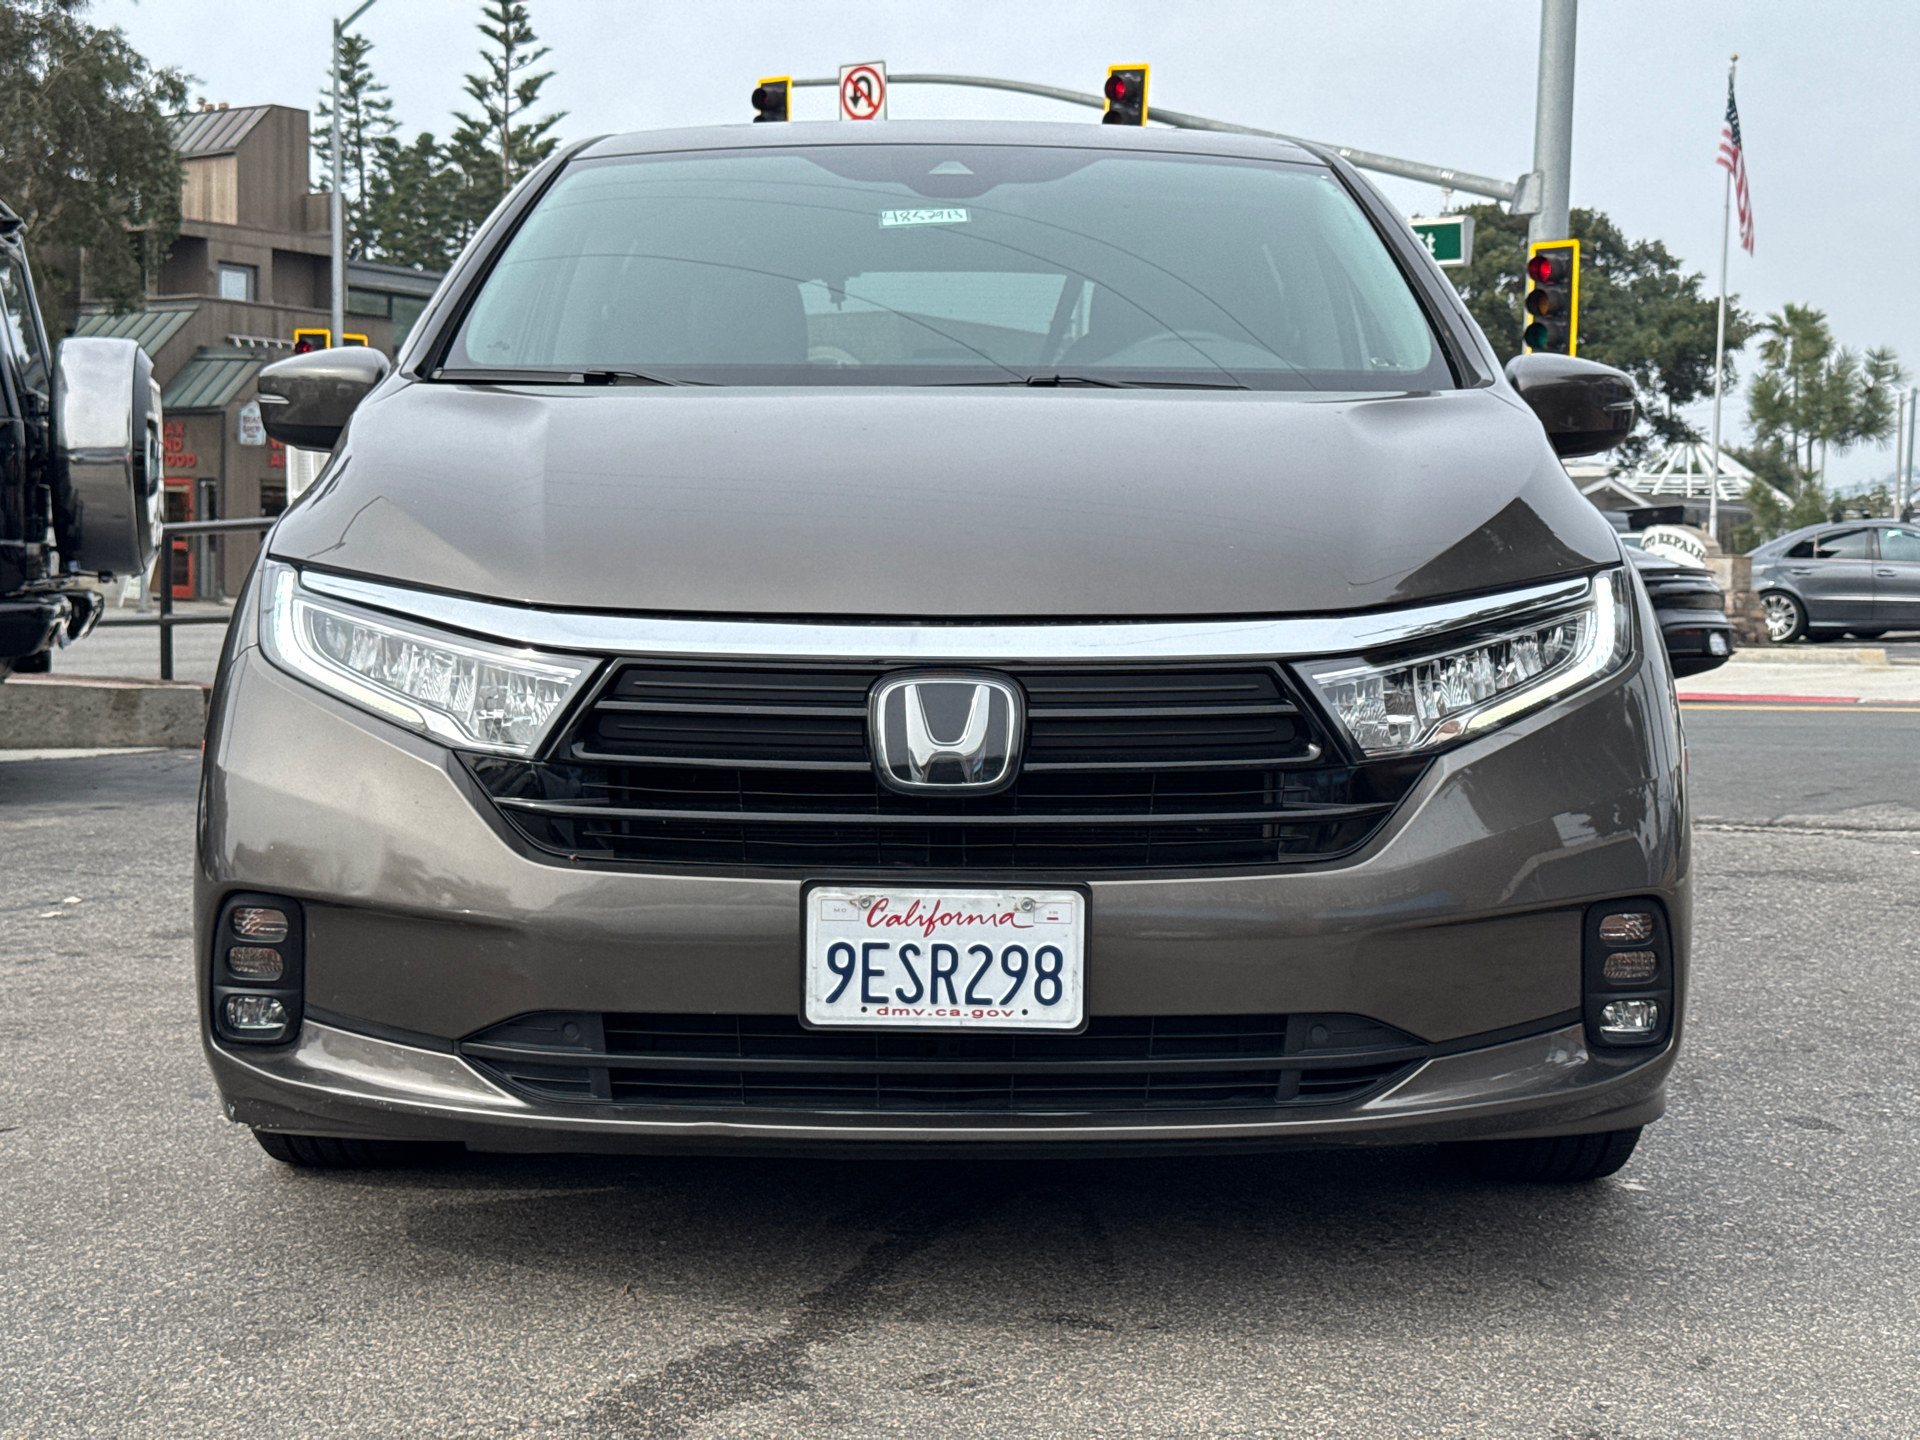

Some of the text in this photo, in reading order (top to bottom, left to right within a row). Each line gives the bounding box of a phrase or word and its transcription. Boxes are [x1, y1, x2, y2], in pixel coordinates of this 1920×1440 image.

[164, 423, 185, 435] AX
[164, 437, 182, 451] ND
[164, 453, 196, 467] OOD
[866, 898, 1034, 937] California
[825, 941, 1064, 1006] 9ESR298
[876, 1006, 1015, 1019] dmv.ca.gov
